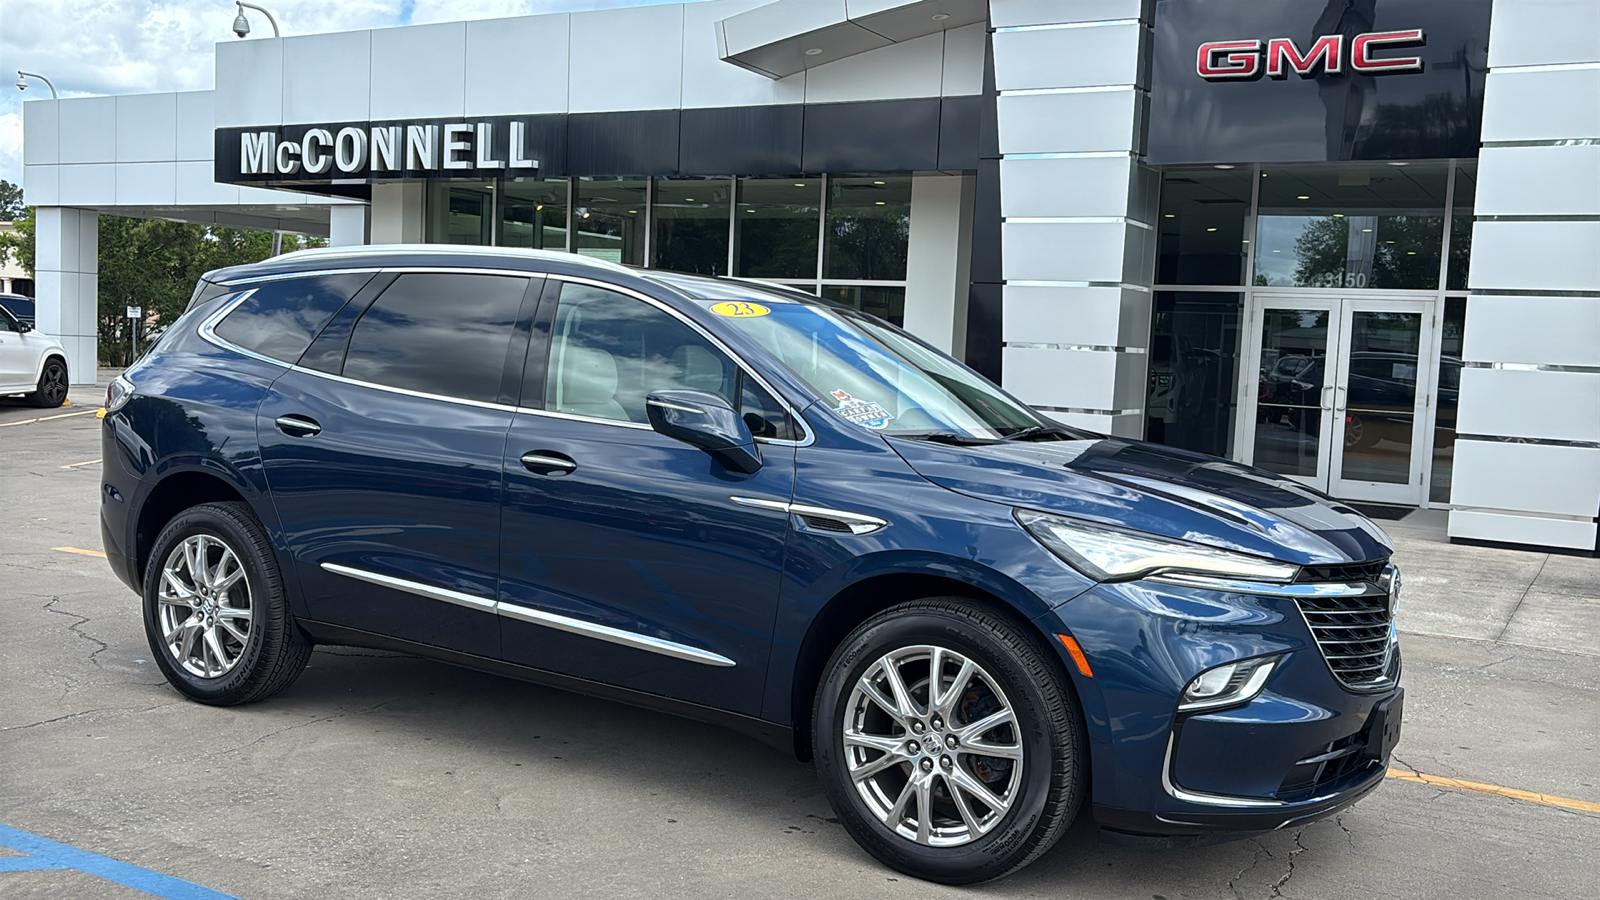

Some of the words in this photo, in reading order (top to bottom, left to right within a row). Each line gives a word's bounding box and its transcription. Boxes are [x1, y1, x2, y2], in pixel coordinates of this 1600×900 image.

[1196, 28, 1425, 80] GMC
[240, 121, 538, 174] McCONNELL
[1324, 272, 1367, 288] 3150
[726, 303, 755, 316] 23
[215, 624, 261, 693] CONTINENTA
